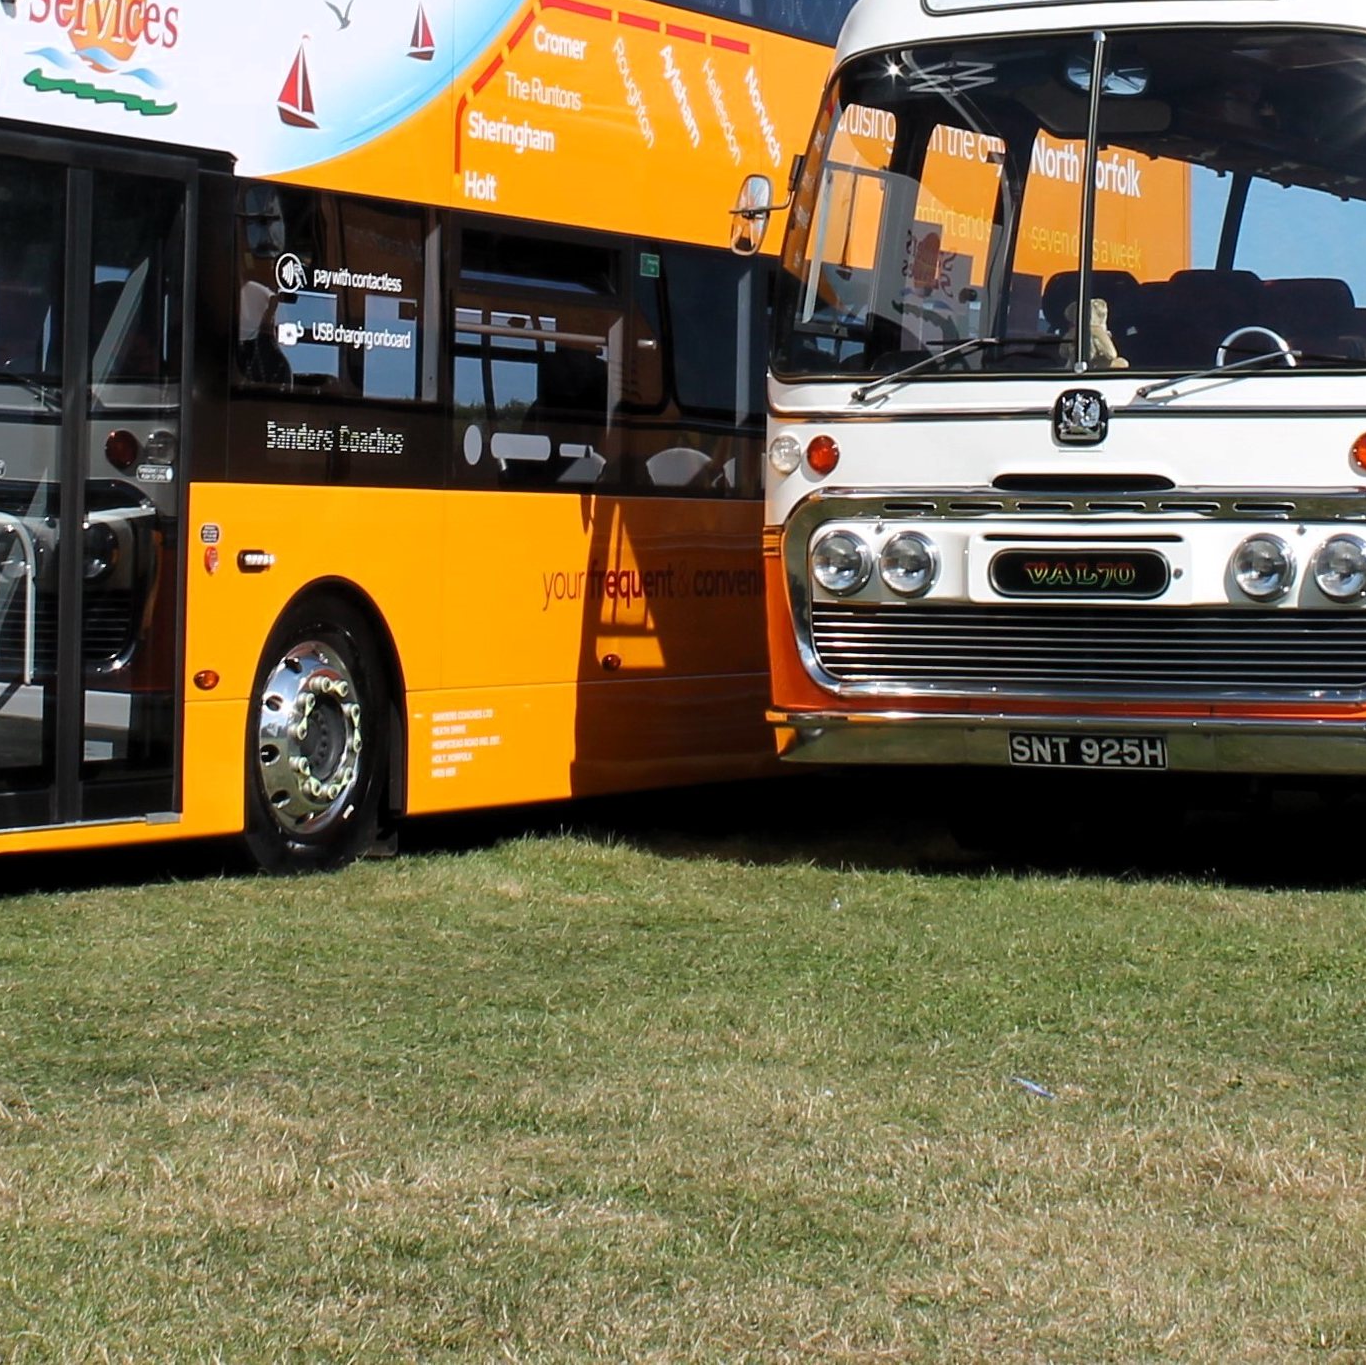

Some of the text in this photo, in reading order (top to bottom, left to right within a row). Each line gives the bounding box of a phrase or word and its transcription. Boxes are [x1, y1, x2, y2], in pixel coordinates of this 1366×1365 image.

[533, 24, 587, 61] Cromer
[505, 71, 582, 111] The Runtons
[613, 37, 655, 149] Roughton
[659, 45, 700, 149] Aylsham
[468, 110, 555, 154] Sheringham
[744, 65, 782, 168] Norwich
[1031, 137, 1079, 184] North
[464, 169, 497, 202] Holt
[313, 267, 403, 292] pay with contactless
[312, 321, 411, 350] USB charging onboard
[266, 420, 404, 454] Sanders Coaches
[542, 570, 585, 611] your
[588, 558, 674, 609] frequent
[1012, 735, 1165, 766] SNT 925H
